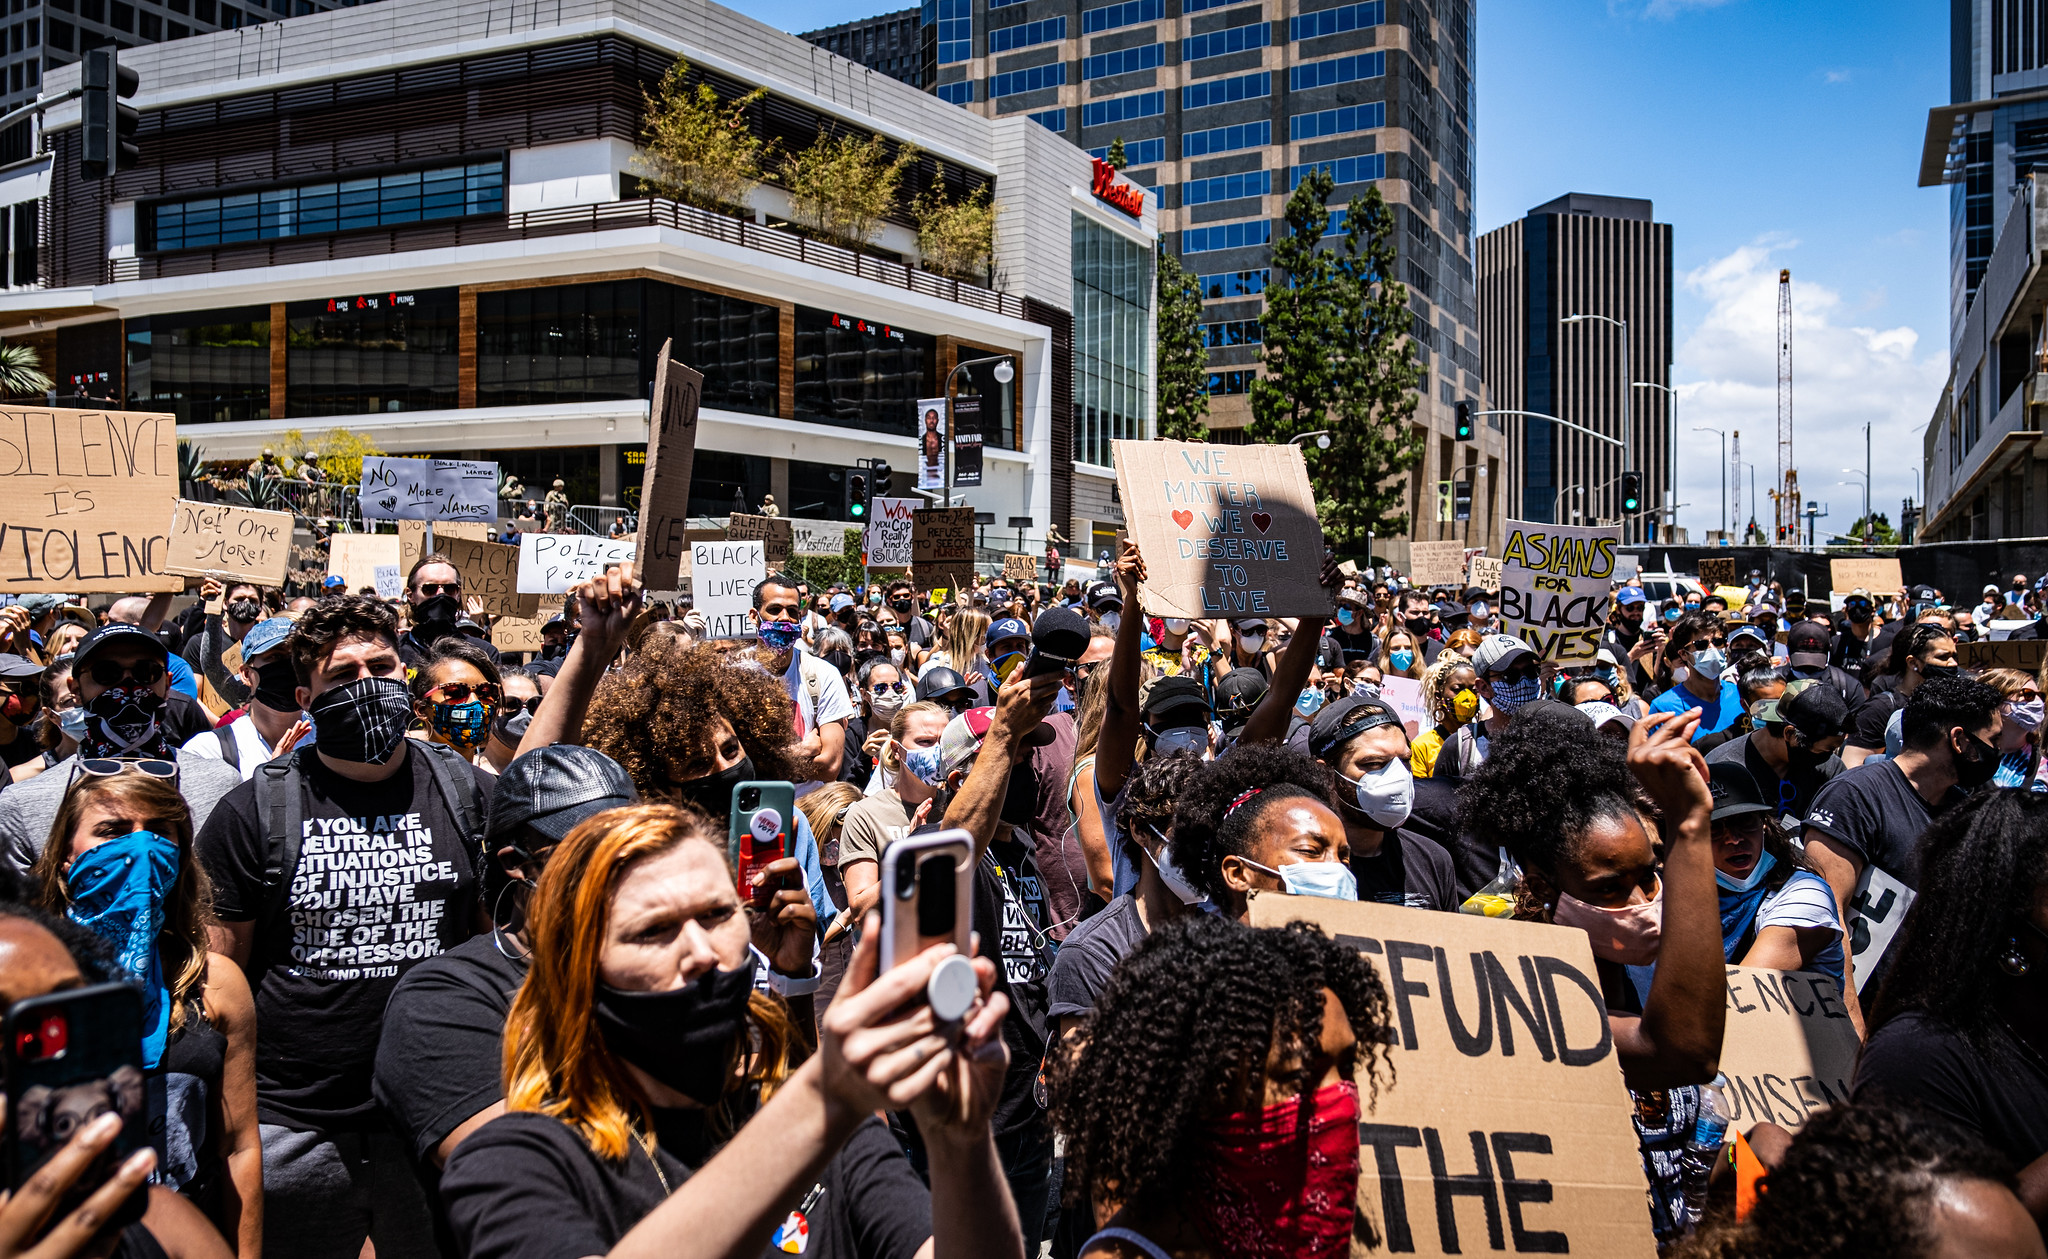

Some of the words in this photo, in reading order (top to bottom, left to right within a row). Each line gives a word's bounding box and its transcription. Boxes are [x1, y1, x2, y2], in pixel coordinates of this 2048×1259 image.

[369, 460, 398, 488] NO
[1181, 450, 1231, 476] WE
[44, 490, 95, 517] IS
[1164, 480, 1263, 510] MATTER
[732, 516, 775, 531] BLACK
[892, 519, 912, 532] Cop
[927, 527, 965, 538] REFUSE
[1201, 510, 1245, 534] WE
[0, 522, 169, 582] IOLENC
[794, 529, 842, 552] Westfield
[915, 540, 931, 549] TO
[936, 539, 953, 549] SEE
[1178, 538, 1289, 561] DESERVE
[696, 545, 762, 567] BLACK
[934, 548, 966, 559] MURDER
[1006, 556, 1024, 570] BLACK
[1025, 557, 1034, 570] IS
[1475, 558, 1502, 572] BLAC
[1503, 530, 1617, 579] ASIANS
[1700, 560, 1733, 569] BLACK
[1214, 564, 1248, 587] TO
[1534, 576, 1571, 593] FOR
[1500, 586, 1609, 629] BLACK
[696, 613, 758, 638] MATTE
[496, 632, 514, 644] TO
[317, 817, 367, 835] YOU
[373, 813, 421, 832] ARE
[406, 828, 432, 847] IN
[291, 873, 324, 895] OF
[330, 861, 458, 890] INJUSTICE,
[290, 890, 341, 910] YOU
[348, 884, 416, 907] HAVE
[291, 905, 393, 927] CHOSEN
[399, 899, 445, 921] THE
[293, 925, 347, 947] SIDE
[351, 924, 387, 945] OF
[391, 919, 439, 941] THE
[1002, 934, 1033, 951] BLA
[291, 939, 445, 967] OPPRESSOR.
[363, 965, 398, 979] TUTU
[1727, 969, 1849, 1019] ENCE
[1359, 1122, 1569, 1254] THE
